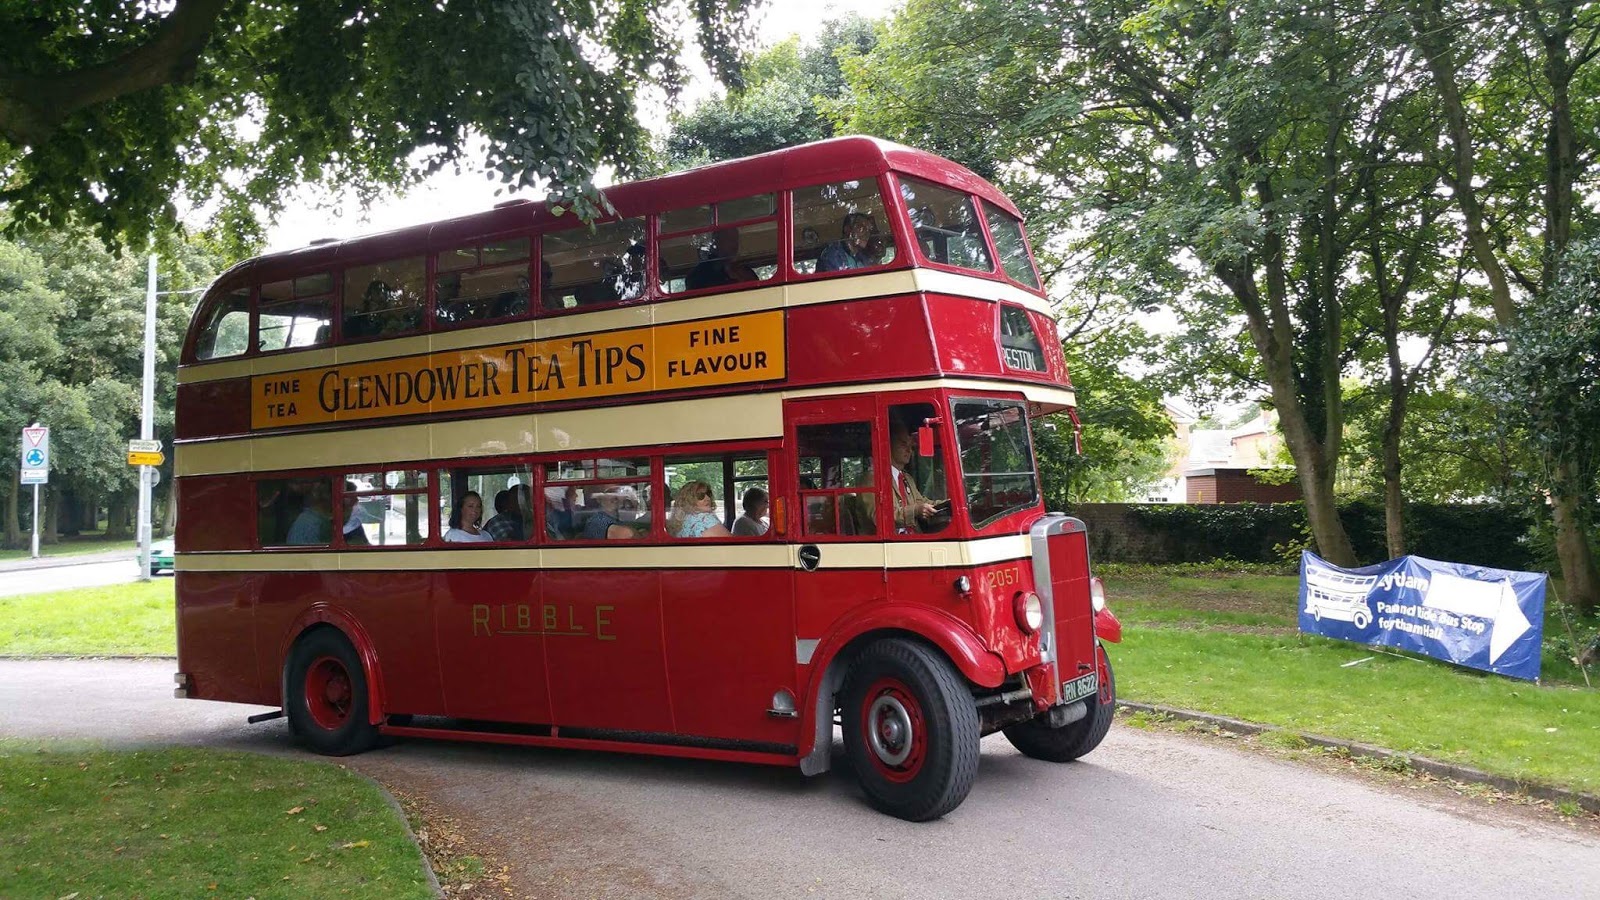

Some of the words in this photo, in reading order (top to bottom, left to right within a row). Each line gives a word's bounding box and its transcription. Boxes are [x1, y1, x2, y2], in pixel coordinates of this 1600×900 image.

[689, 326, 740, 348] FINE
[668, 351, 767, 378] FLAVOUR
[318, 361, 502, 413] GLENDOWER
[505, 348, 565, 394] TEA
[572, 339, 646, 388] TIPS
[264, 379, 300, 397] FINE
[267, 402, 298, 419] TEA
[987, 567, 1019, 588] 2057
[472, 604, 617, 640] RIBBLE
[1423, 624, 1444, 640] Hall
[1460, 616, 1485, 635] Stop
[1065, 682, 1077, 701] RN
[1077, 675, 1096, 696] 8622
